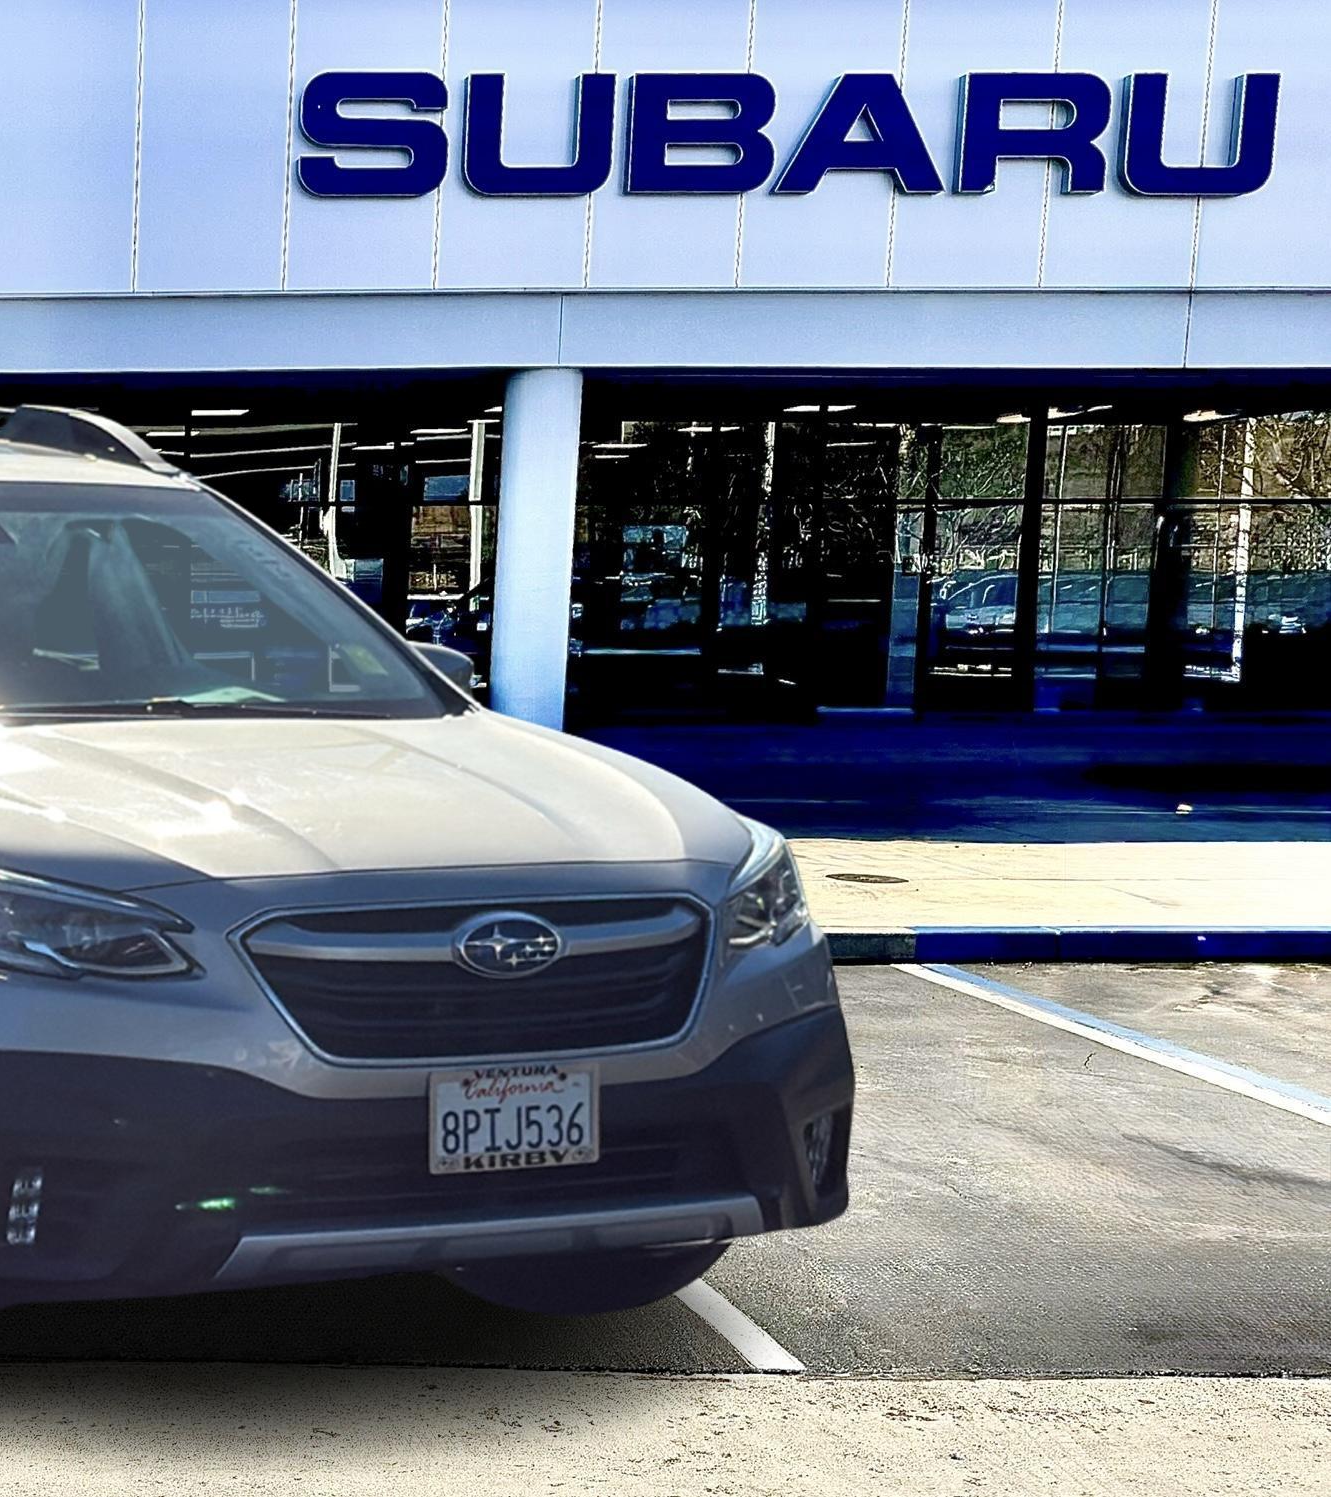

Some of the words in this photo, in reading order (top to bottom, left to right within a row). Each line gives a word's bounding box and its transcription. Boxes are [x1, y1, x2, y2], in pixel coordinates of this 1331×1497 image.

[296, 72, 1280, 200] SUBARU
[474, 1064, 559, 1079] VENTURA
[463, 1076, 566, 1104] California
[441, 1102, 584, 1155] 8PIJ536
[463, 1149, 570, 1170] KIRBY
